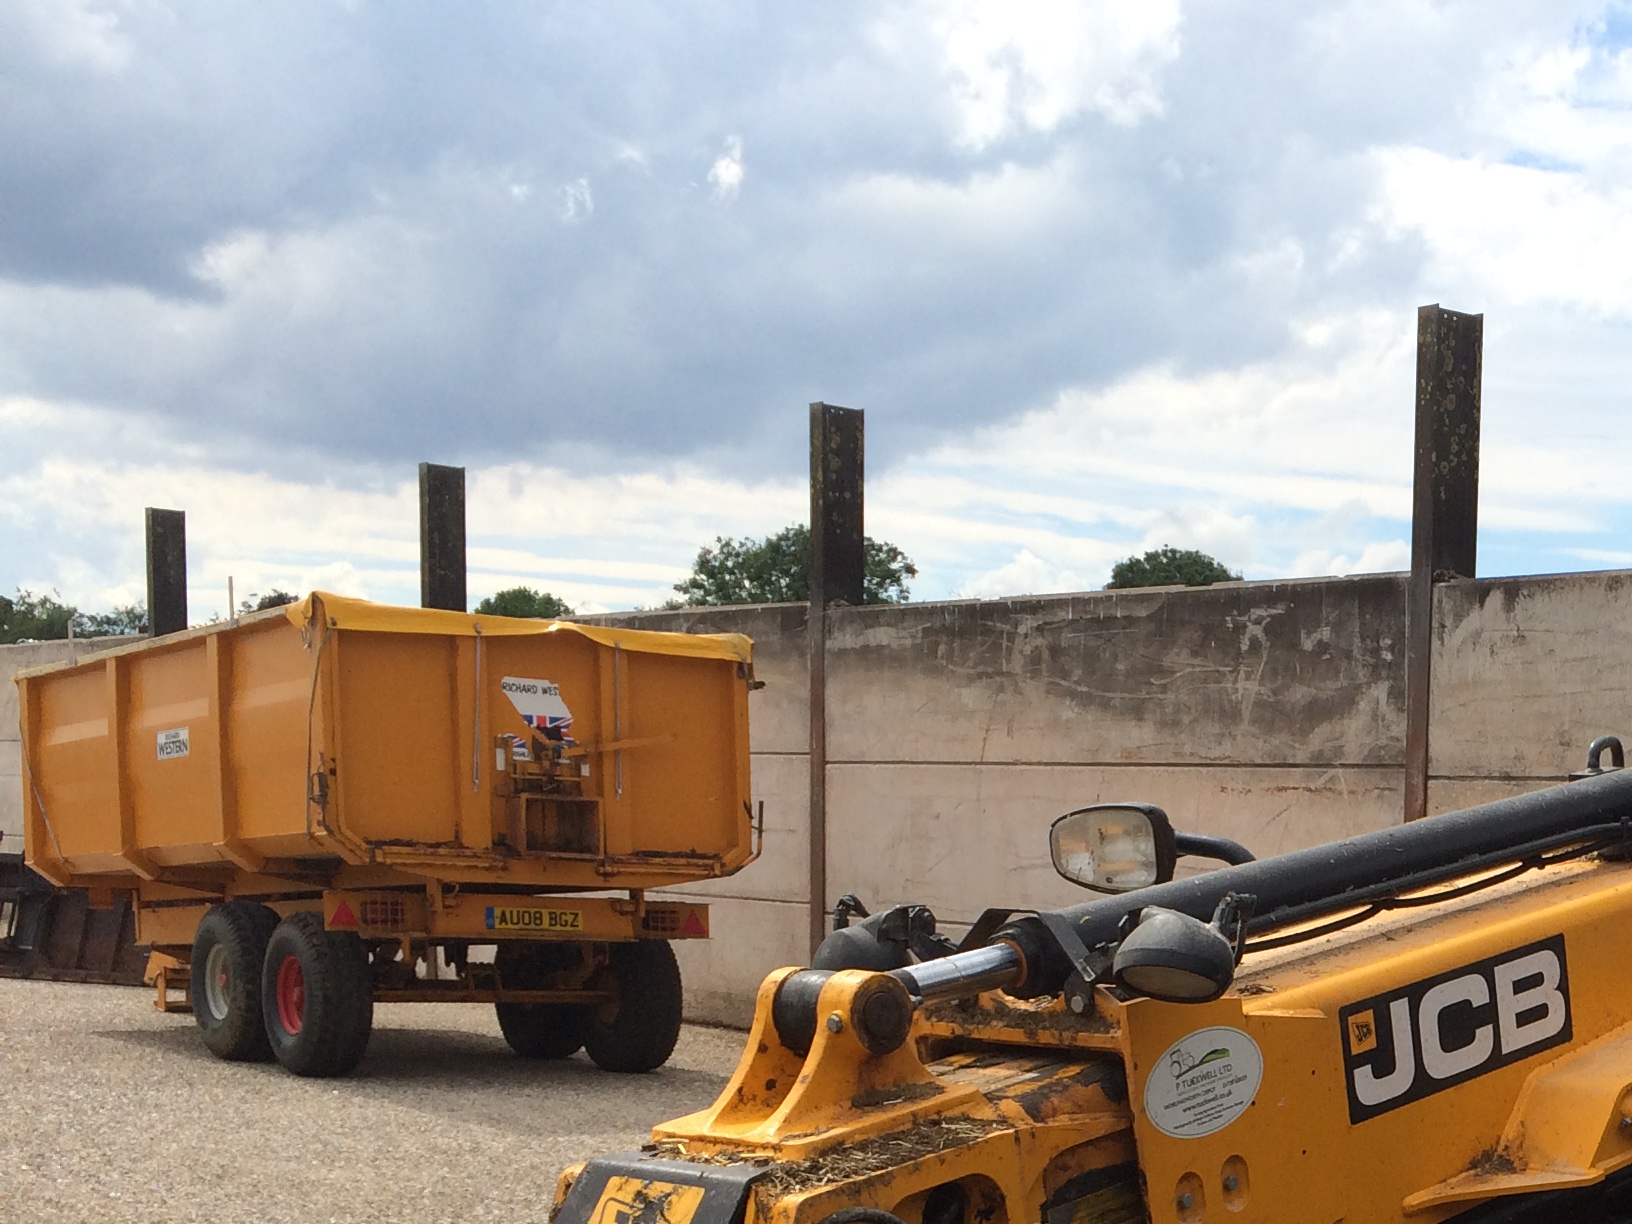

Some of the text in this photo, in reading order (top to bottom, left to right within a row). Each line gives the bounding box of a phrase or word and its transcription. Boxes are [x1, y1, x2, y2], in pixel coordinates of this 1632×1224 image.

[502, 682, 537, 694] RICHARD
[158, 738, 188, 756] WESTERN
[498, 910, 580, 928] AU08 BGZ
[1353, 949, 1566, 1106] JCB
[1219, 1063, 1232, 1075] LTD
